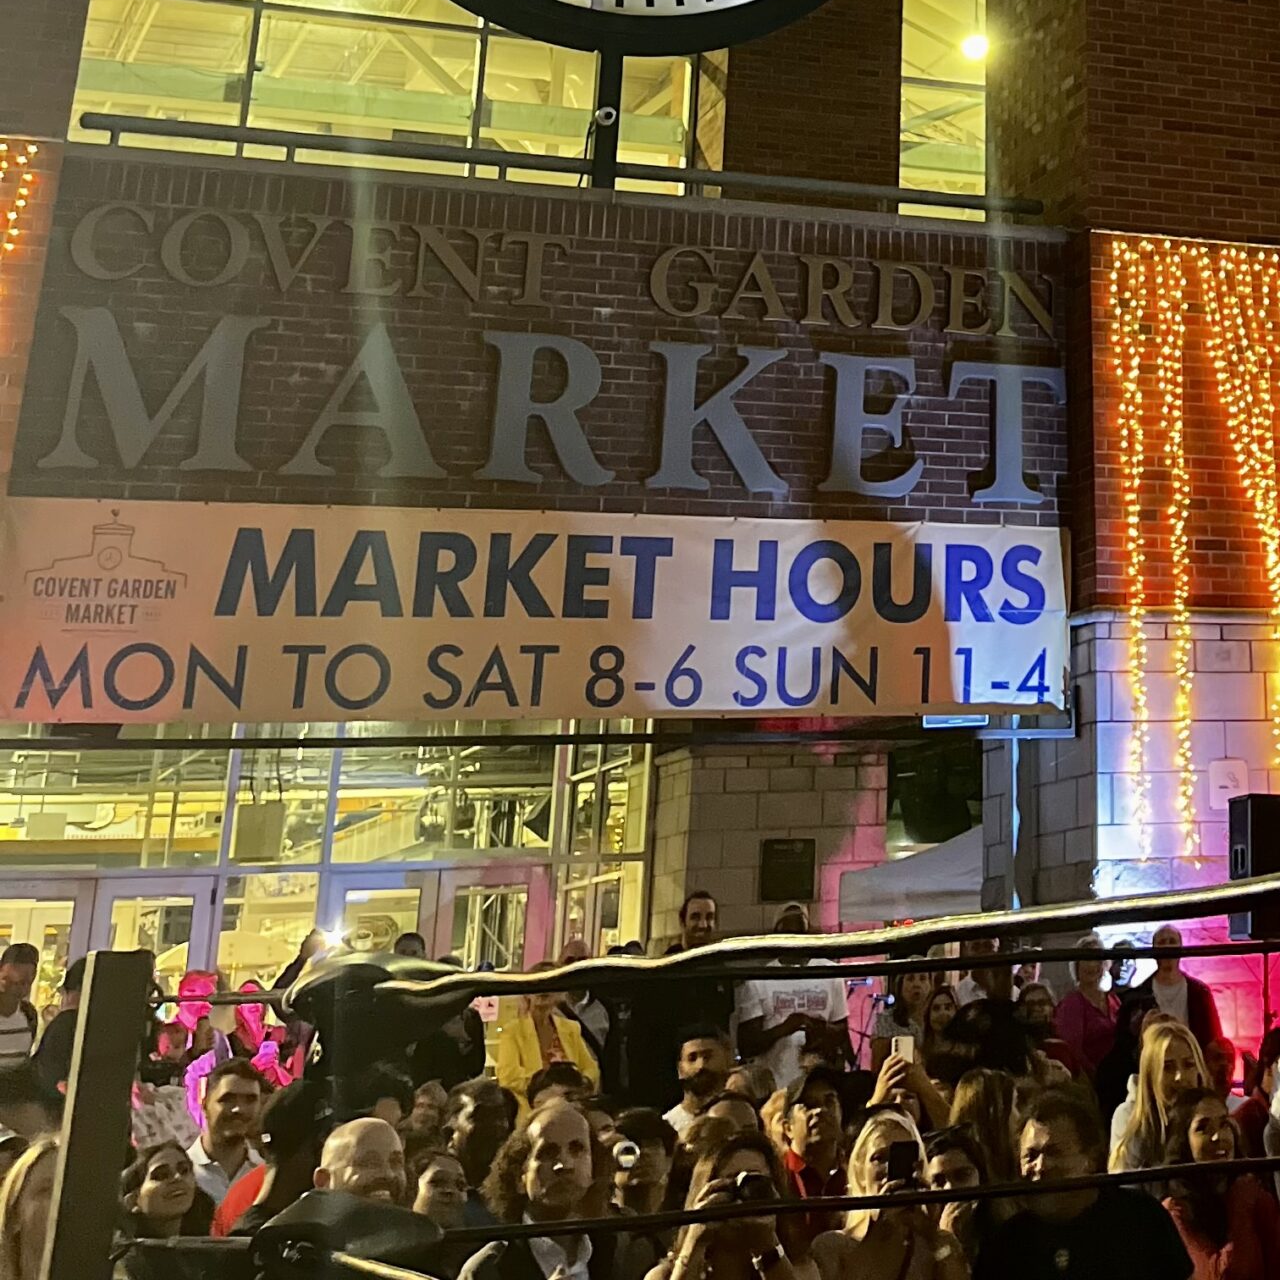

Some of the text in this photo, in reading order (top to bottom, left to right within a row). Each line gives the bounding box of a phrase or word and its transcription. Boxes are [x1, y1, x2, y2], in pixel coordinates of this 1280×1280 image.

[70, 203, 1056, 342] COVENT GARDEN
[37, 306, 1067, 504] MARKET
[33, 576, 178, 600] COVENT GARDEN
[65, 603, 139, 625] MARKET
[213, 527, 1047, 624] MARKET HOURS
[14, 642, 1051, 711] MON TO SAT 8-6 SUN 11-4
